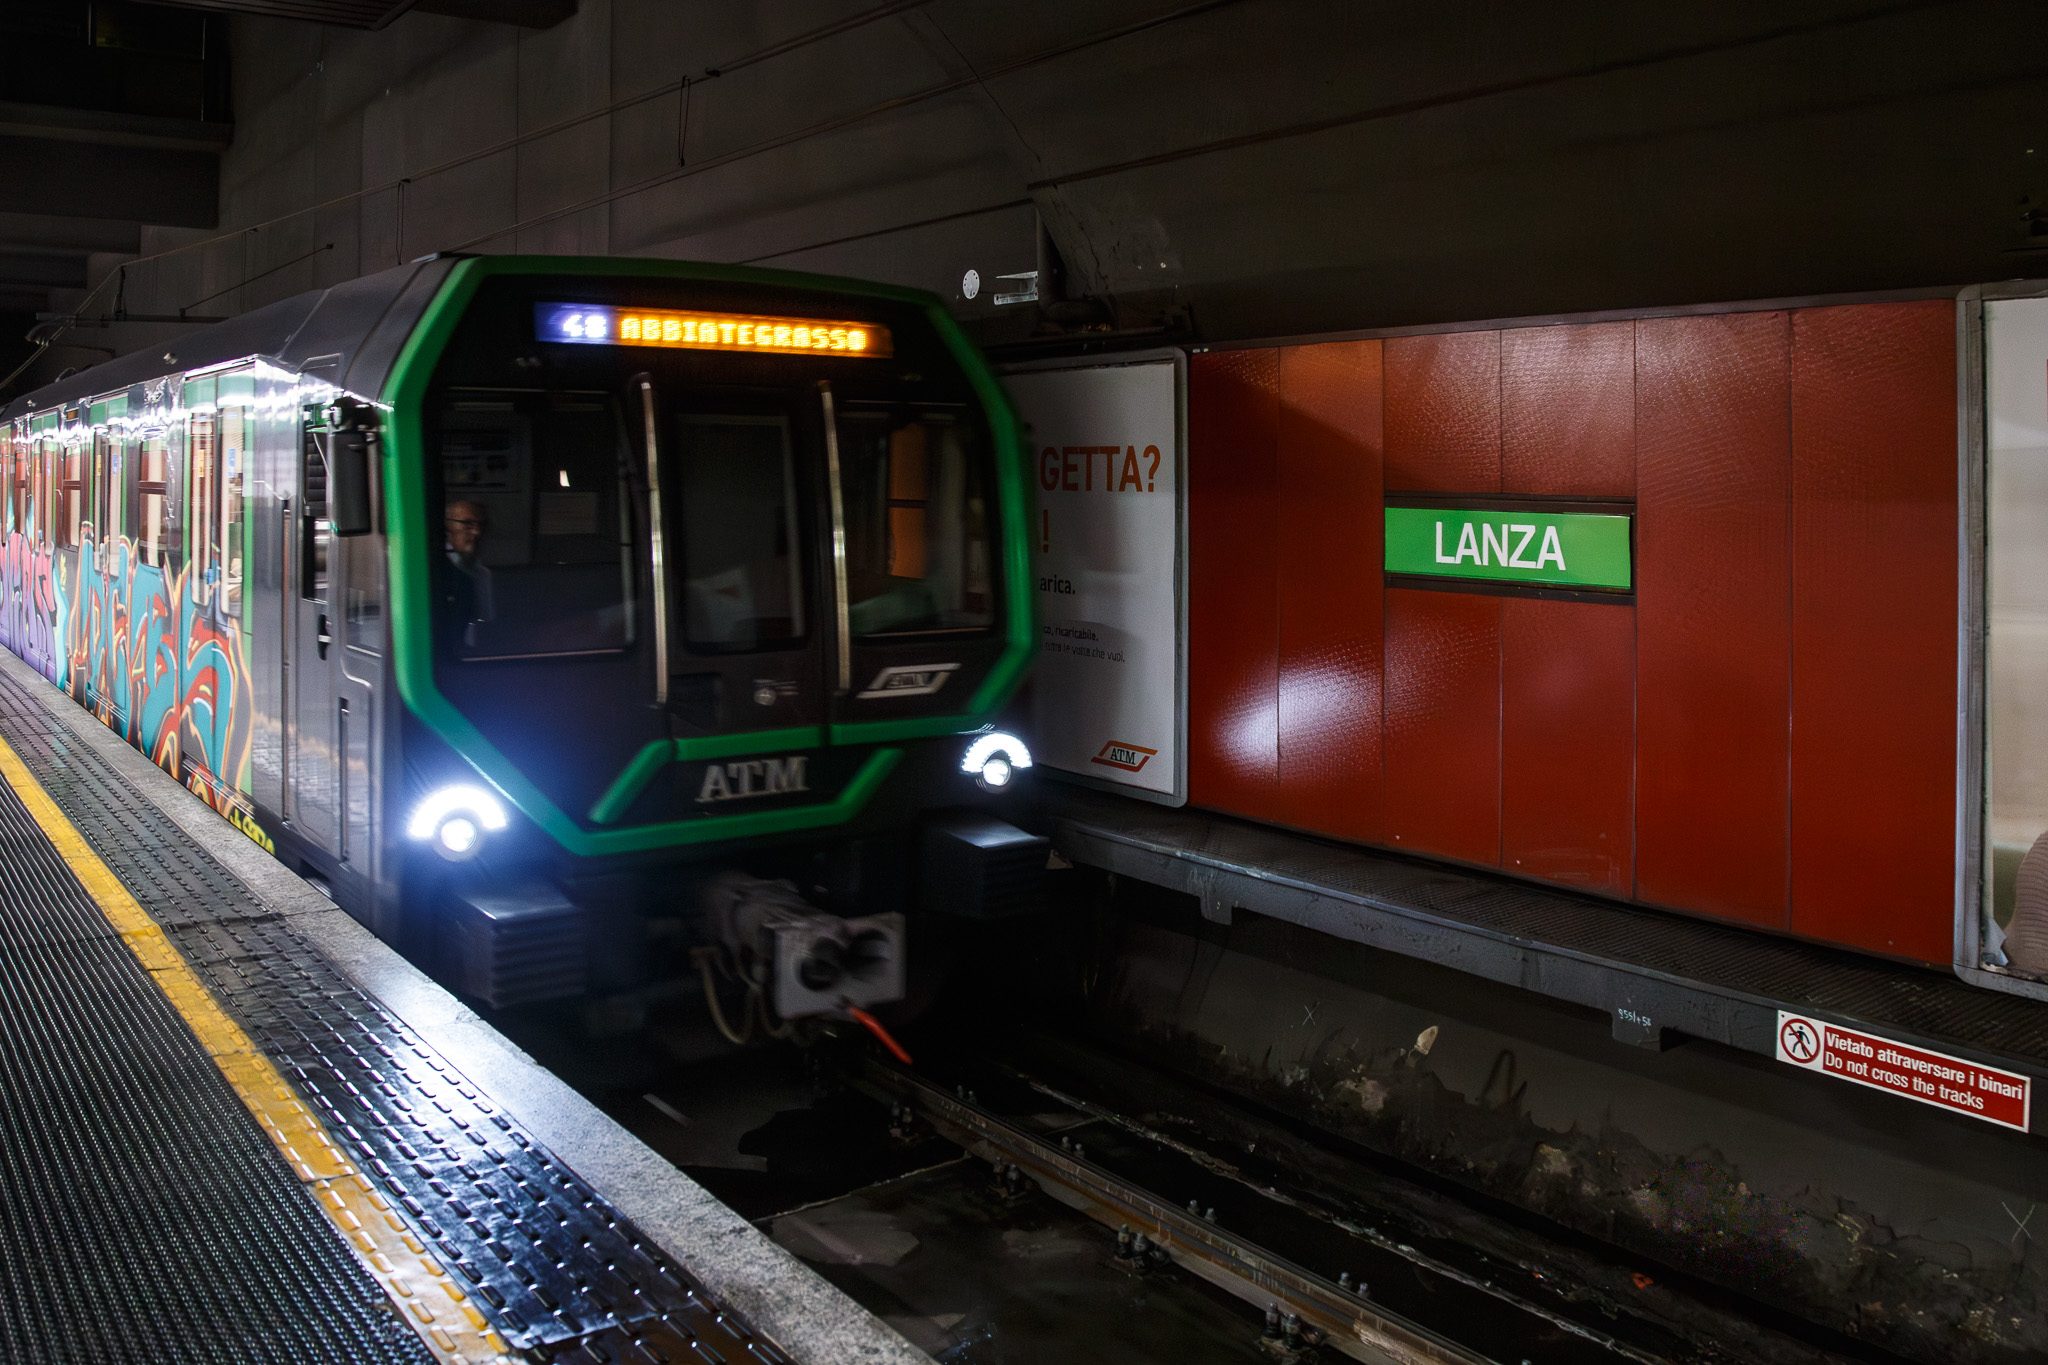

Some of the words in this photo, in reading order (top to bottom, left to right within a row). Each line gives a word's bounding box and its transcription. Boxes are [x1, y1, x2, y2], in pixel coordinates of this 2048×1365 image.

[621, 318, 866, 351] ABBIATEGRASSO
[1040, 444, 1161, 493] GETTA?
[1435, 521, 1566, 571] LANZA
[694, 756, 811, 802] ATM
[1110, 747, 1136, 765] ATM
[1825, 1031, 1874, 1058] Vietato
[1877, 1048, 1965, 1084] attraversare
[1969, 1071, 1975, 1087] i
[1978, 1073, 2023, 1100] binari
[1825, 1051, 1843, 1069] Do
[1846, 1060, 1869, 1077] not
[1871, 1067, 1909, 1089] cross
[1912, 1076, 1935, 1096] the
[1938, 1083, 1985, 1110] tracks
